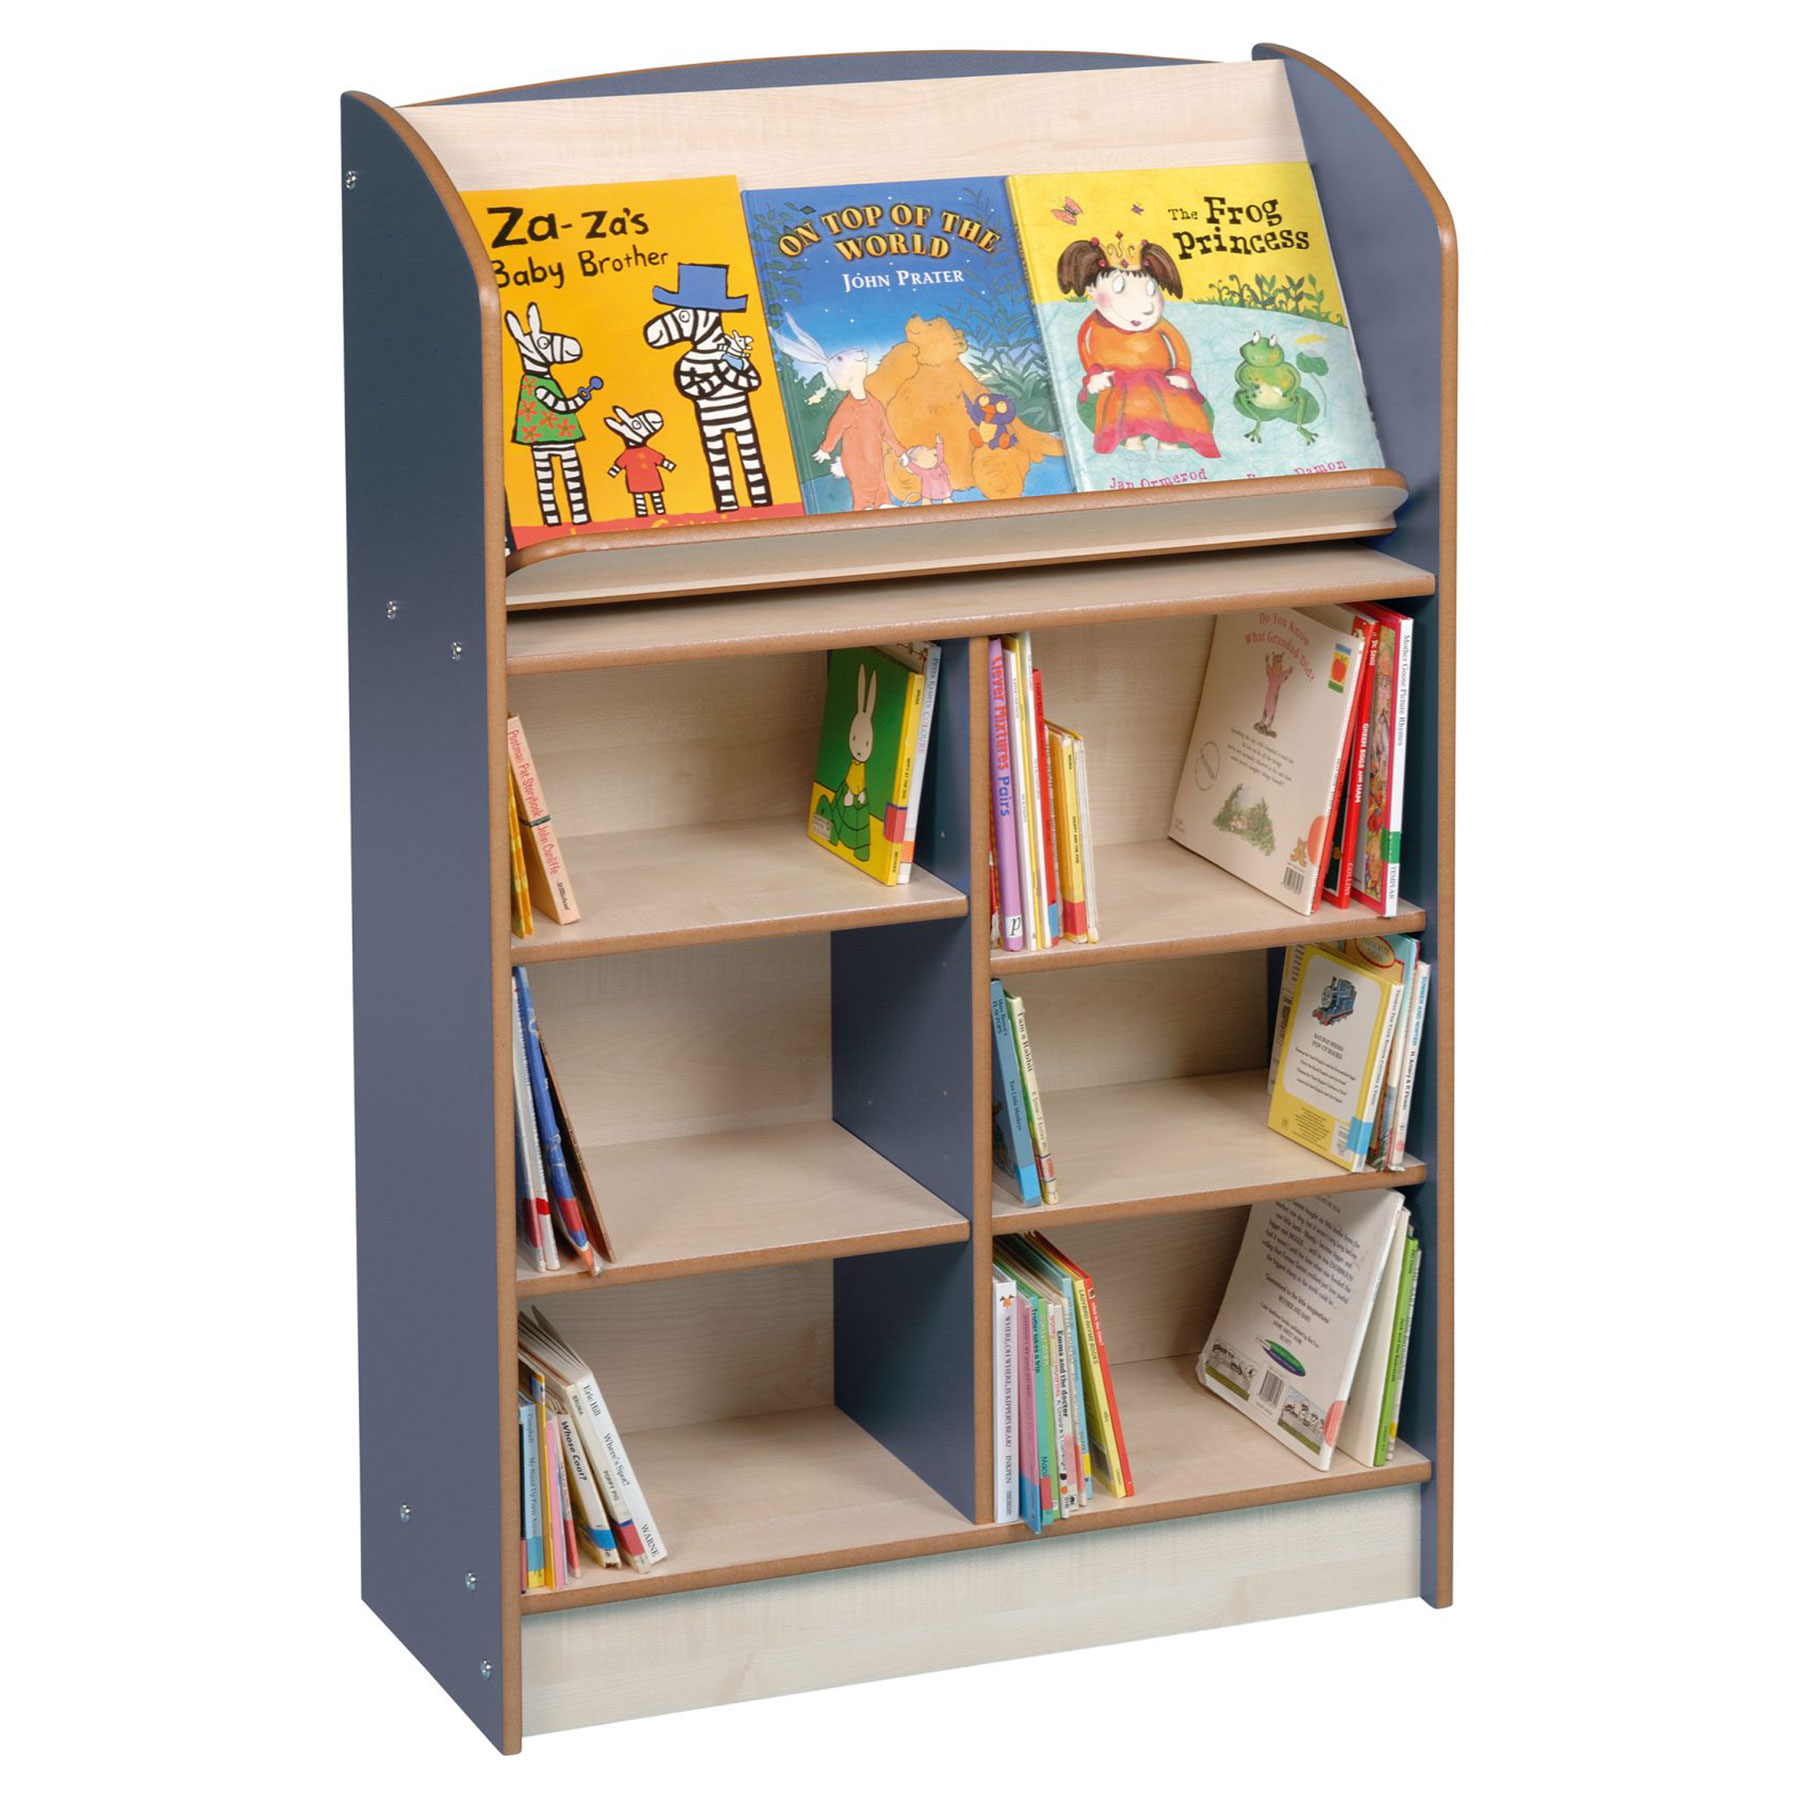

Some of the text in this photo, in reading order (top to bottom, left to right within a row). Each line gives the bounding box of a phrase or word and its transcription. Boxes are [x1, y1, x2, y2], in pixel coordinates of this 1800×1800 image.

[778, 203, 1001, 257] ON TOP OF THE
[1168, 196, 1283, 227] The Frog
[834, 233, 950, 261] WORLD
[490, 244, 669, 288] Baby Brother
[843, 270, 965, 292] JOHN PRATER
[992, 655, 1007, 701] Clever
[1396, 634, 1410, 746] Mother Goose Picture Rhymes
[505, 729, 523, 763] Postman
[518, 762, 530, 779] Pat
[1358, 749, 1366, 768] EGGS
[998, 776, 1010, 817] Pairs
[536, 825, 549, 844] John
[1417, 976, 1428, 1004] SUMMER
[1018, 1018, 1025, 1033] am
[1022, 1040, 1033, 1072] Rabbit
[1411, 1019, 1420, 1046] WINTER
[1078, 1289, 1099, 1364] LADYBIRD RHYME BOOKS
[1058, 1357, 1066, 1373] and
[583, 1384, 601, 1417] Eric Hill
[561, 1421, 575, 1453] Whose
[572, 1454, 587, 1481] Coat?
[604, 1433, 630, 1486] Where's Spot?
[641, 1523, 658, 1557] WARNE
